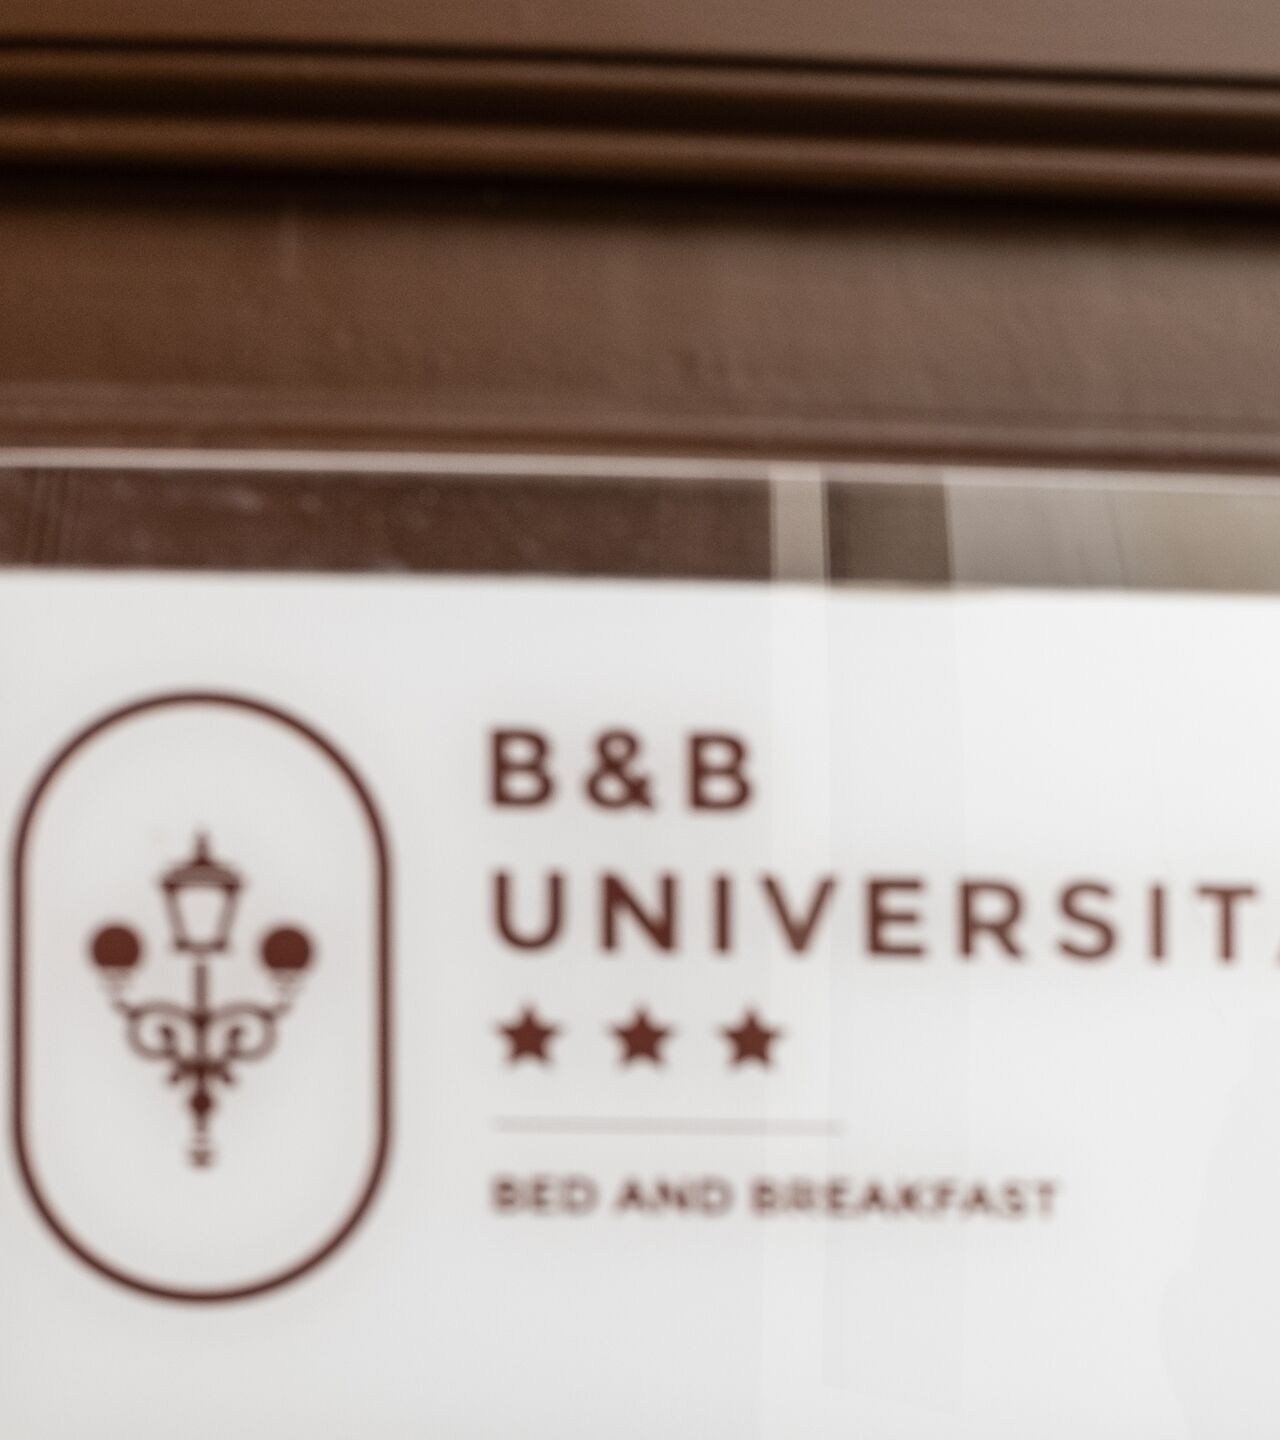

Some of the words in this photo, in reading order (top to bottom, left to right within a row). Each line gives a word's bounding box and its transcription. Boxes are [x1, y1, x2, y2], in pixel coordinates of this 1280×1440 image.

[487, 726, 756, 815] B&B
[491, 1174, 599, 1218] BED
[613, 1176, 734, 1218] AND
[748, 1176, 1060, 1221] BREAKFAST
